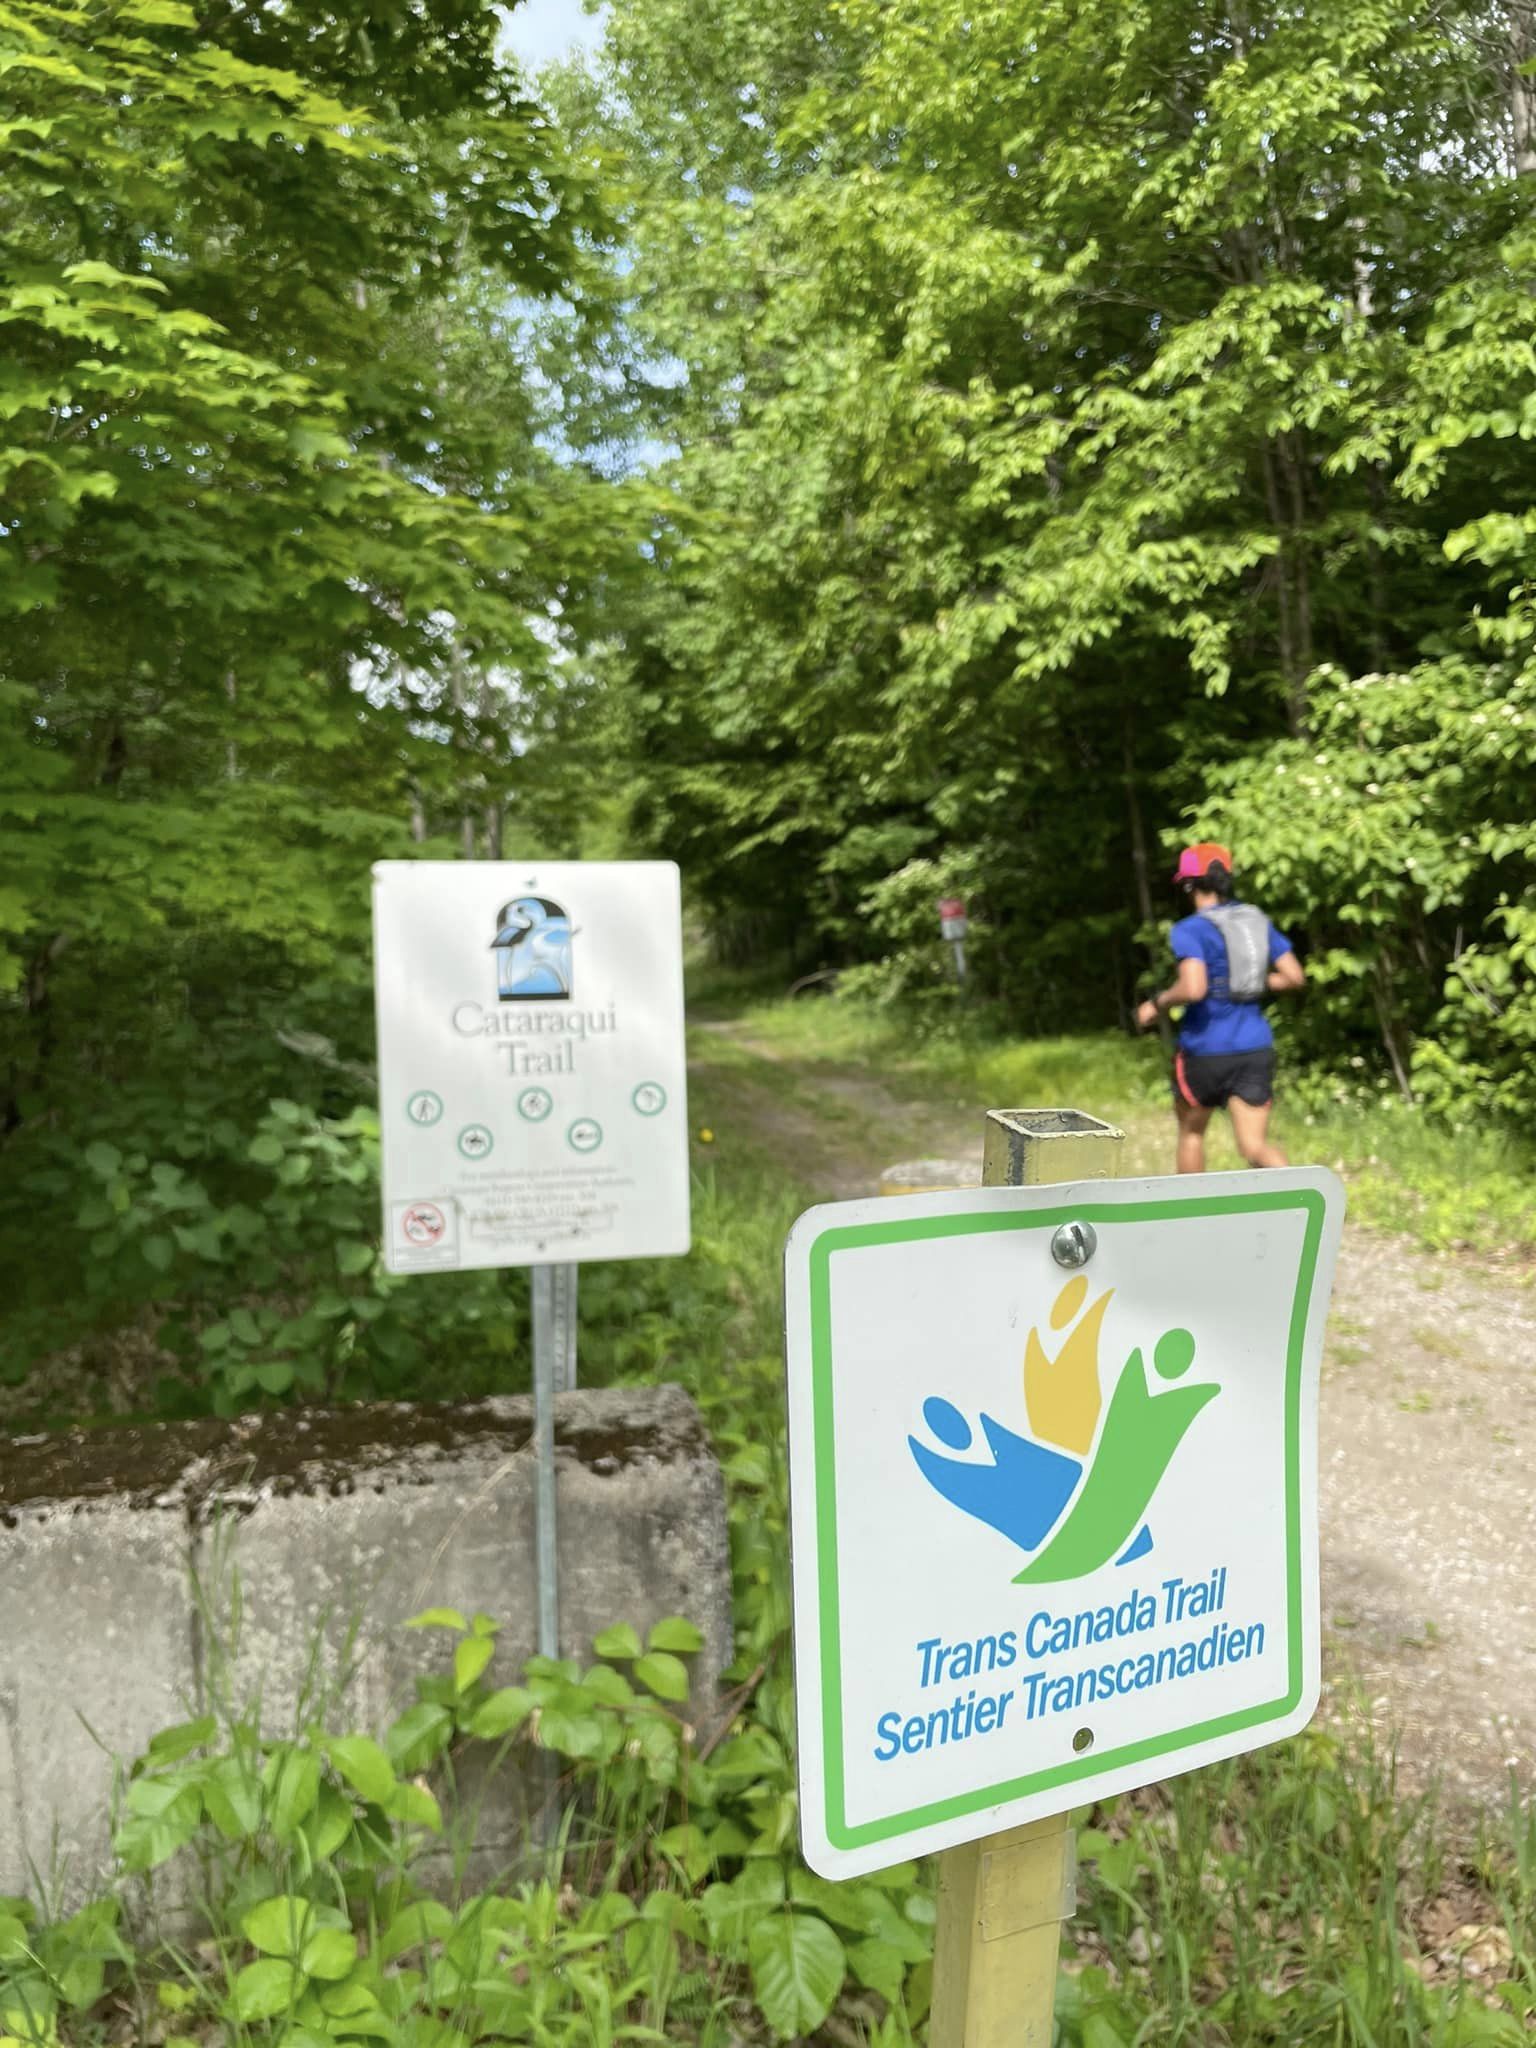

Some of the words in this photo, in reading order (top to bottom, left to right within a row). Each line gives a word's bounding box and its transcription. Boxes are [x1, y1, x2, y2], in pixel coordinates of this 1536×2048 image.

[452, 1000, 617, 1040] Cataraqui
[498, 1040, 575, 1075] Trail
[916, 1629, 1018, 1688] Trans
[1025, 1589, 1157, 1659] Canada
[1161, 1567, 1228, 1623] Trail
[873, 1690, 1014, 1761] Sentier
[1022, 1622, 1266, 1720] Transcanadien
